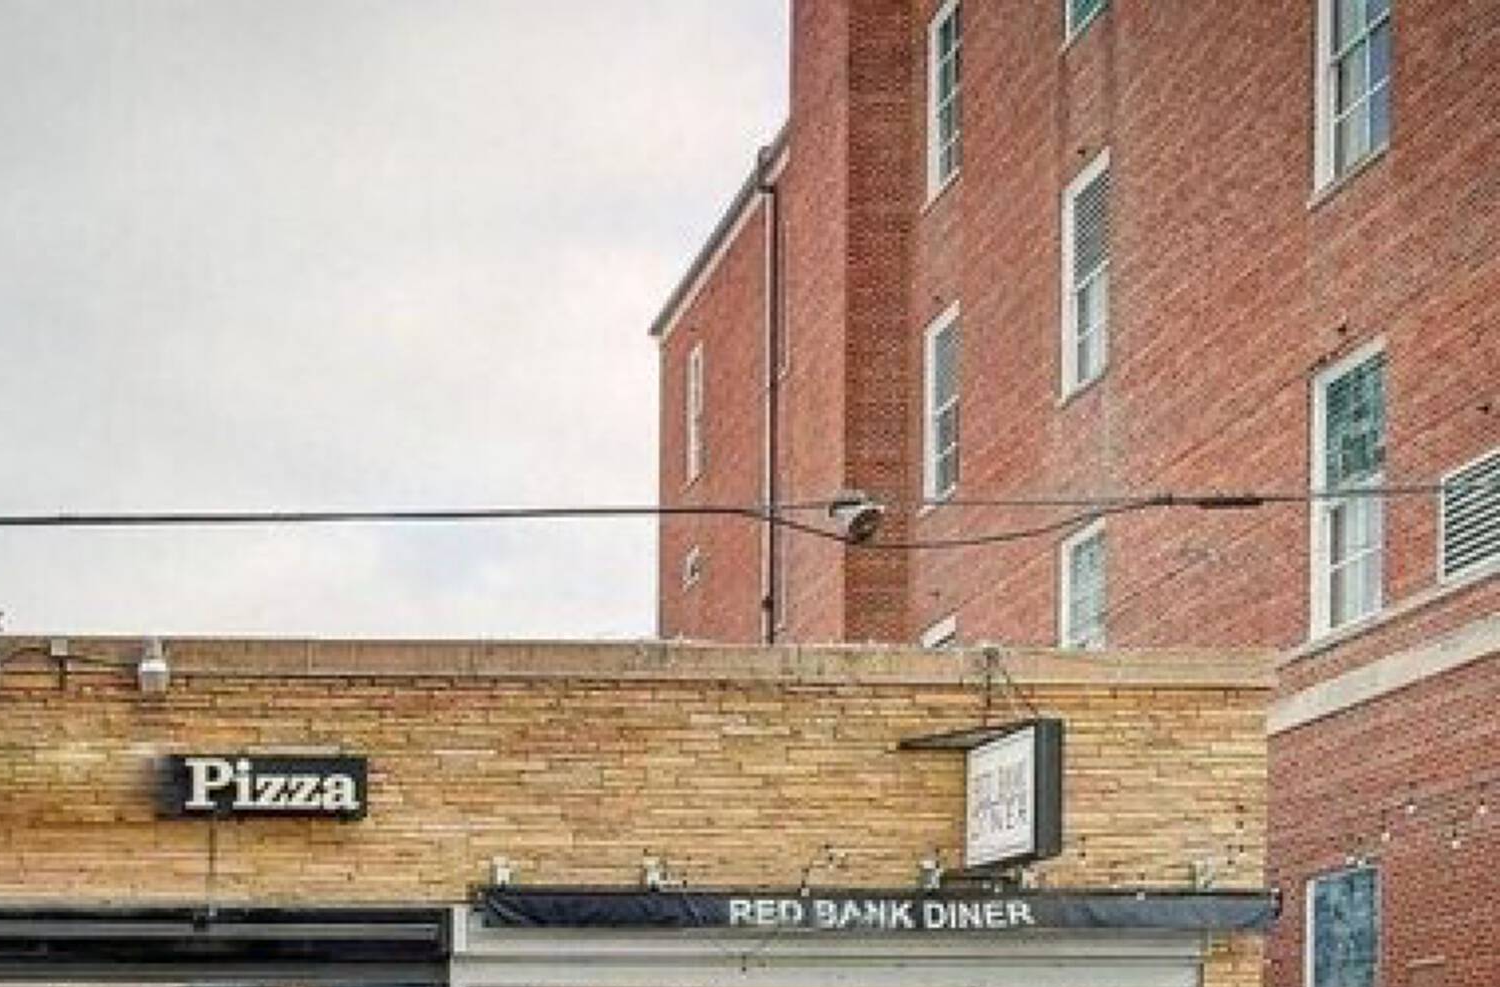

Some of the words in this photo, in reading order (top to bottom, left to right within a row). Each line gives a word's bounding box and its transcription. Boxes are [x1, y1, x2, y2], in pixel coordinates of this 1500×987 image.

[185, 757, 360, 810] Pizza
[729, 899, 802, 926] RED
[813, 899, 916, 929] BANK
[923, 899, 1035, 930] DINER
